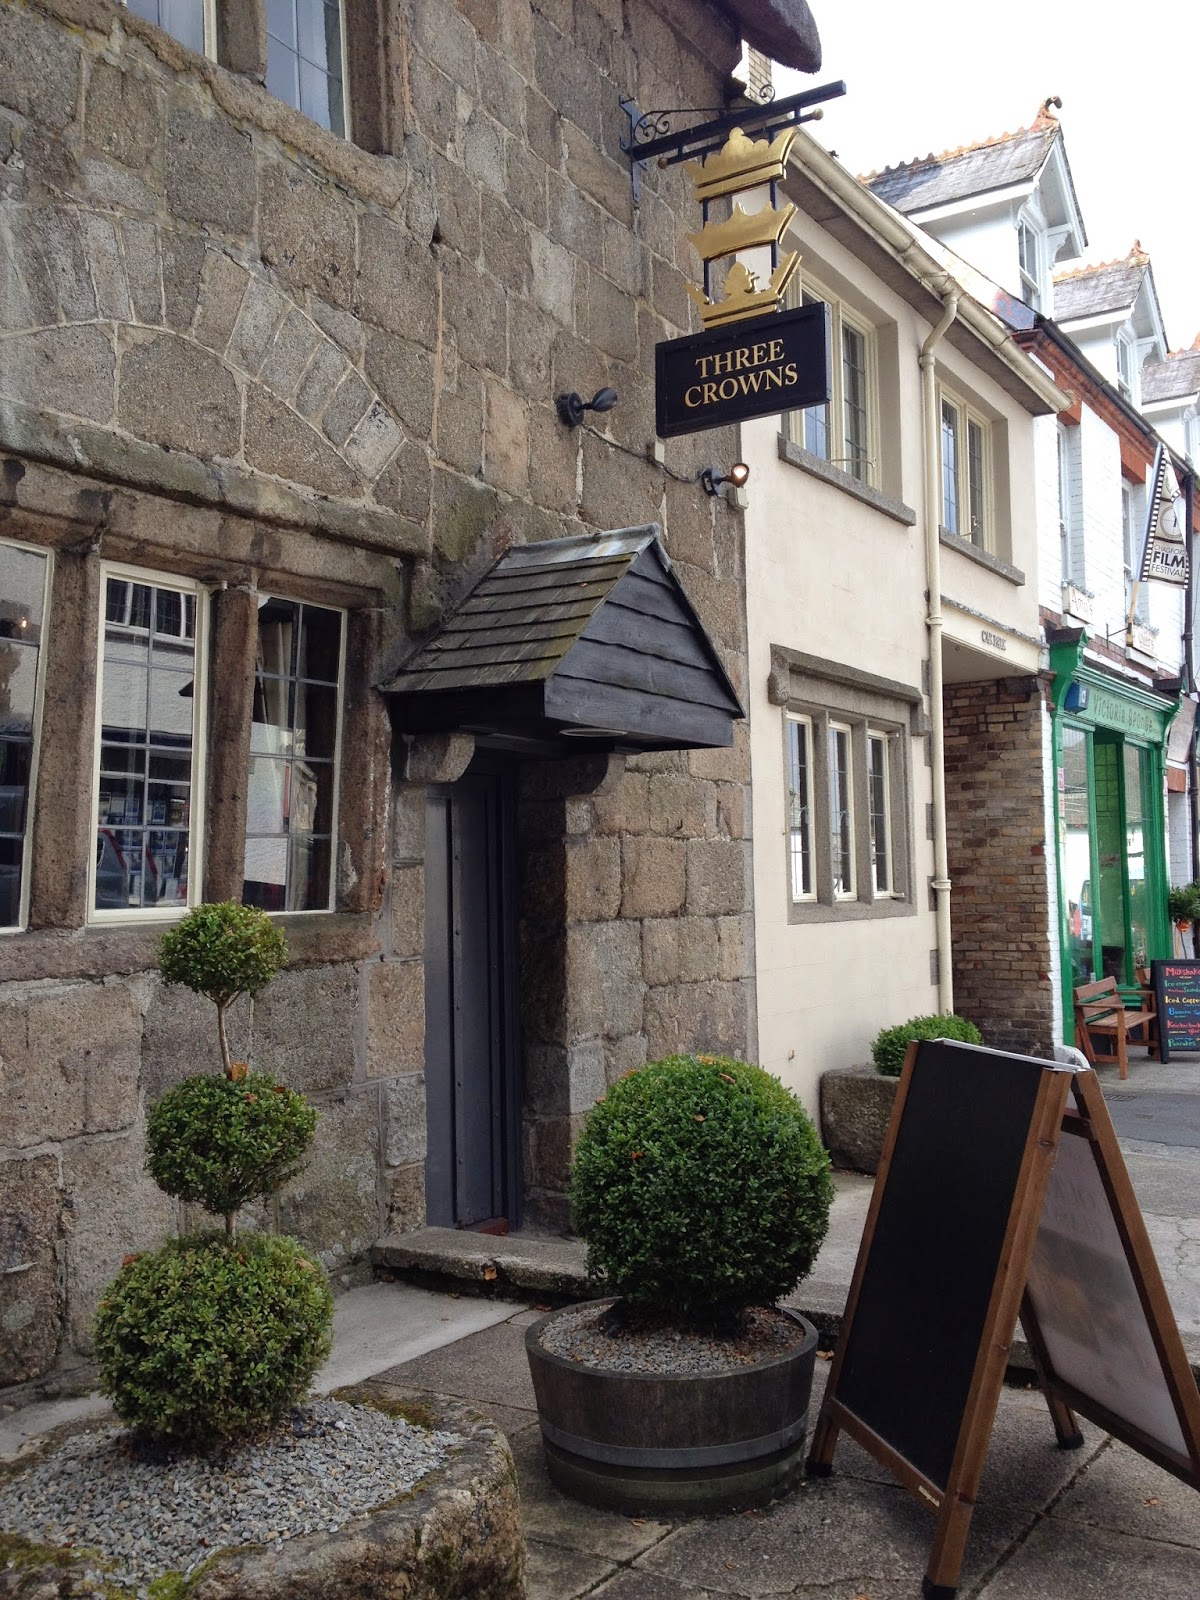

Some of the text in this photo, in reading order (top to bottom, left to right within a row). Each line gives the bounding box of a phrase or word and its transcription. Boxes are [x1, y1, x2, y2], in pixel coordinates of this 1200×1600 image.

[695, 338, 786, 379] THREE
[684, 363, 798, 408] CROWNS
[1152, 551, 1186, 569] FILM
[1151, 564, 1185, 578] FESTIVAL
[1164, 995, 1180, 1004] Iced
